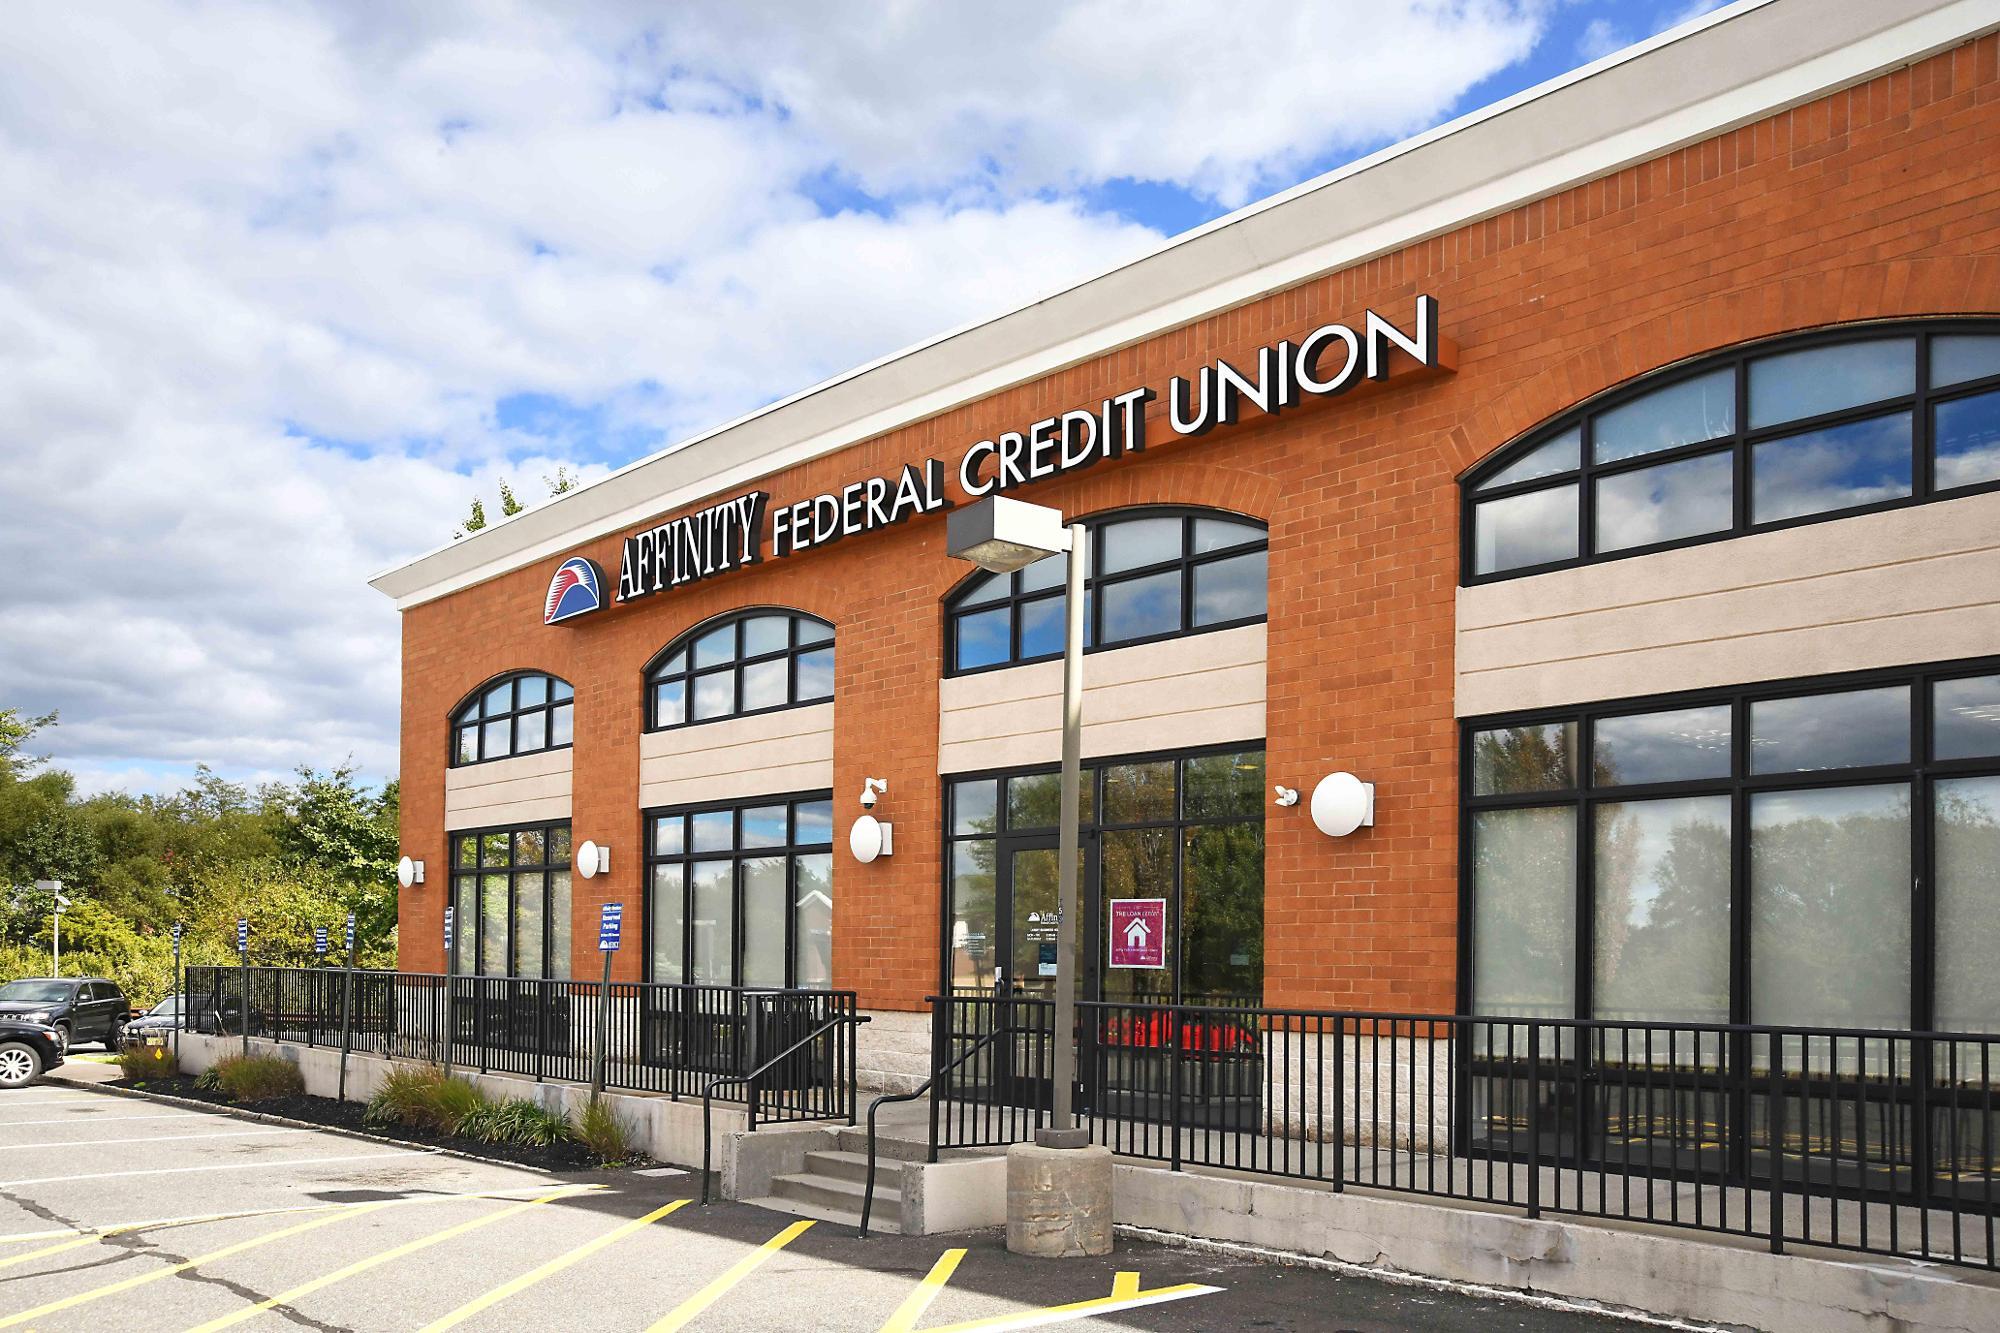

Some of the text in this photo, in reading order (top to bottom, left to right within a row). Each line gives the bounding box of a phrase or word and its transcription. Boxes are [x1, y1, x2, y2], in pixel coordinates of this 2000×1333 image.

[616, 294, 1432, 602] AFFINITY FEDERAL CREDIT UNION
[1041, 912, 1058, 922] Affin
